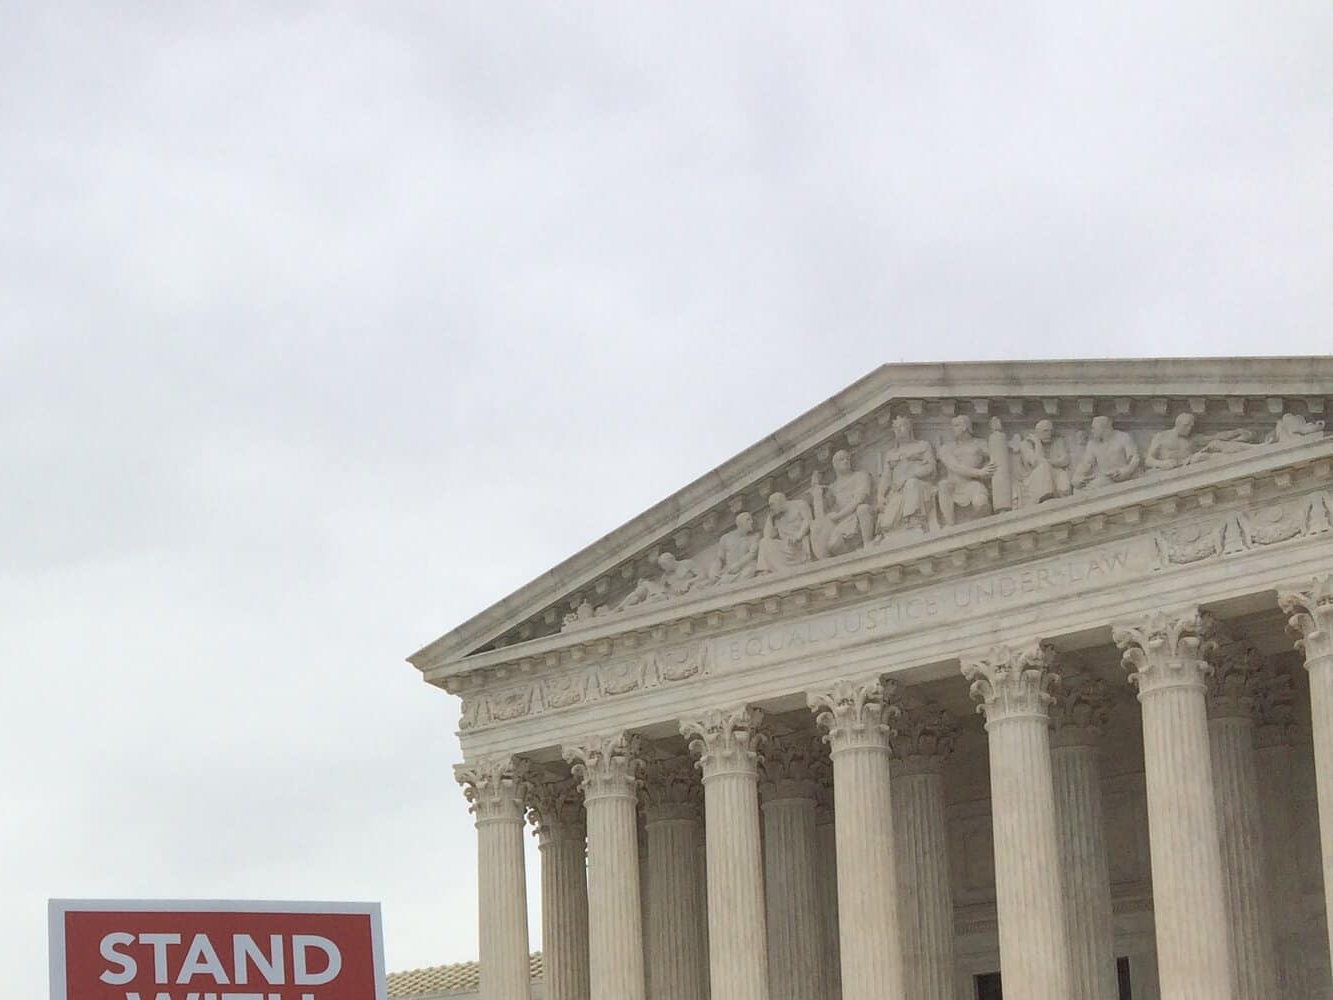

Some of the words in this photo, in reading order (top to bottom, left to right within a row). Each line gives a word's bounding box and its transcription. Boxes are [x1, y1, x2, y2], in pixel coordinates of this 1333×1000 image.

[729, 625, 819, 662] EQUAL
[829, 599, 938, 639] JUSTICE
[952, 566, 1051, 608] UNDER
[1070, 551, 1130, 581] LAW
[99, 932, 343, 986] STAND
